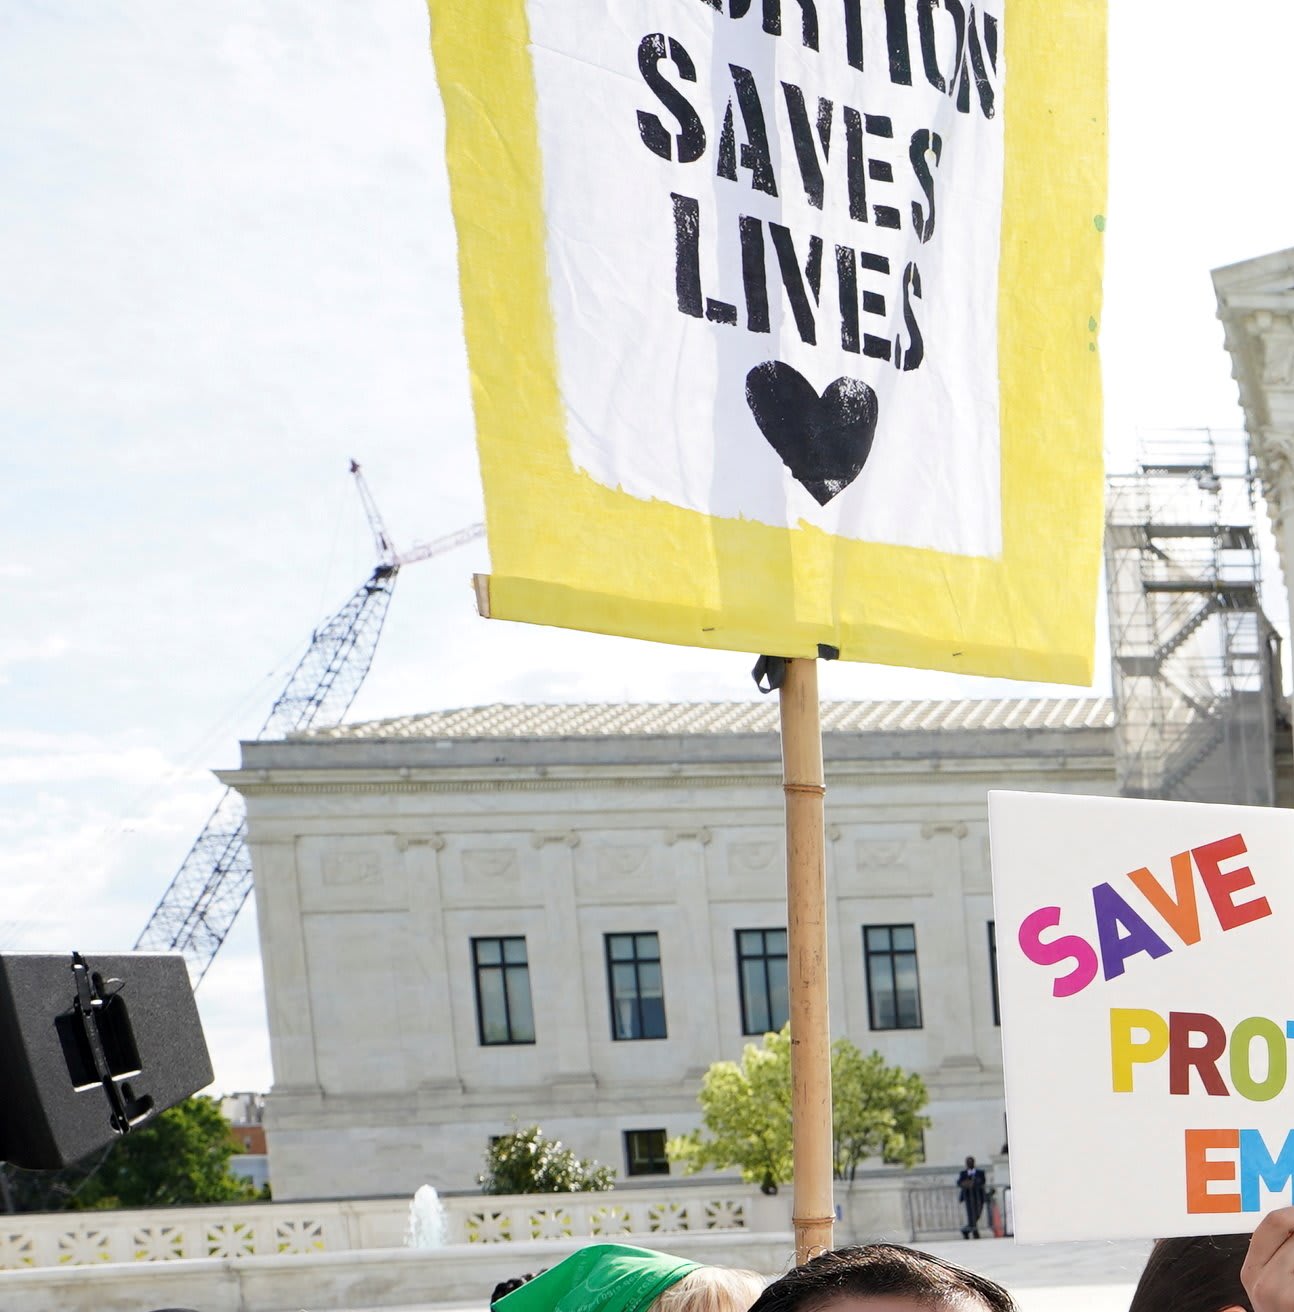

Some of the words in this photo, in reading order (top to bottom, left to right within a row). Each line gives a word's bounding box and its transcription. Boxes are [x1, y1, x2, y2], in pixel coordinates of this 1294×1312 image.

[635, 33, 942, 244] SAVES
[705, 0, 999, 120] TION
[670, 192, 923, 372] LIVES
[1018, 833, 1272, 998] SAVE
